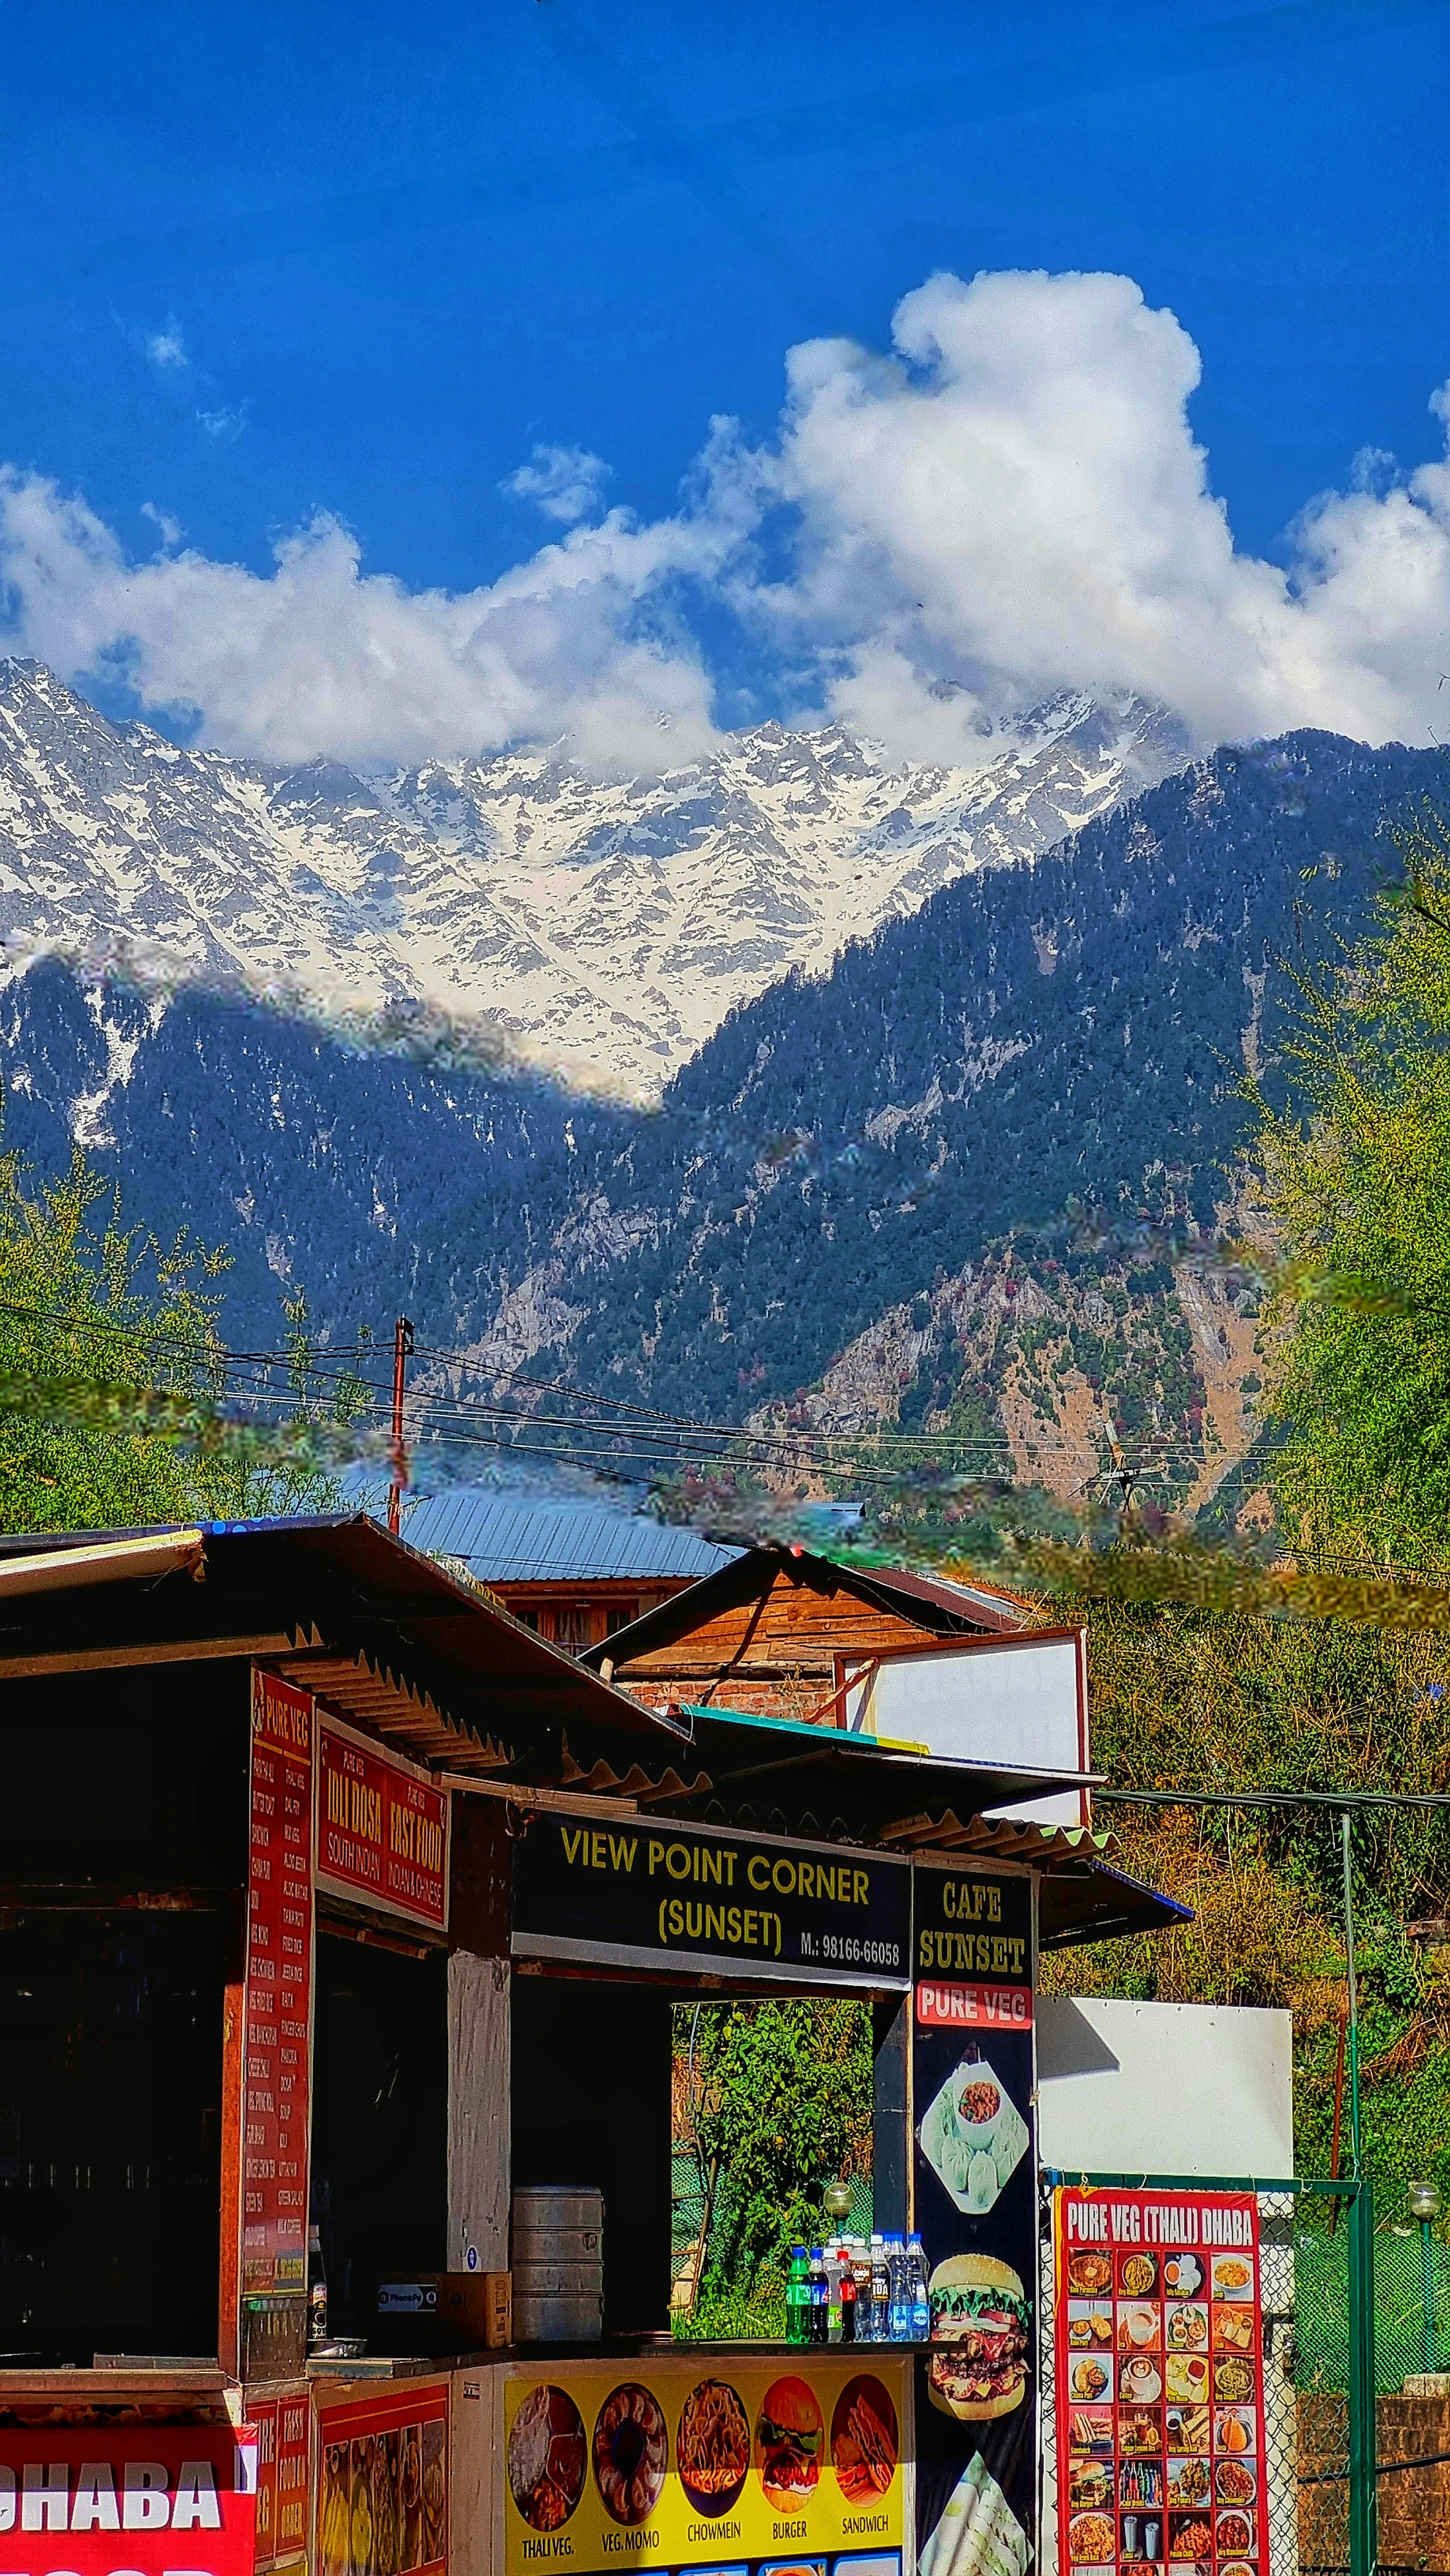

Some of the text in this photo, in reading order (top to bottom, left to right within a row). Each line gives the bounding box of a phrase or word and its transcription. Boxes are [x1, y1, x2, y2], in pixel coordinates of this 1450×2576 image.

[267, 1695, 308, 1747] PURE VEG
[328, 1768, 349, 1829] IDLI
[352, 1781, 381, 1844] DOSA
[328, 1831, 354, 1870] SOUTH
[391, 1801, 442, 1873] FAST FOOD
[561, 1827, 869, 1904] VIEW POINT CORNER
[943, 1881, 1001, 1922] CAFE
[659, 1899, 781, 1956] (SUNSET)
[919, 1929, 1024, 1973] SUNSET
[922, 1987, 1026, 2022] PURE VEG
[1068, 2202, 1253, 2246] PURE VEG (THALI) DHABA
[283, 2407, 304, 2443] FRESH
[601, 2530, 660, 2552] VEG. MOMO
[687, 2521, 741, 2542] CHOWMEIN
[772, 2520, 807, 2539] BURGER
[842, 2514, 889, 2534] SANDWICH
[522, 2537, 575, 2559] THALI VEG.
